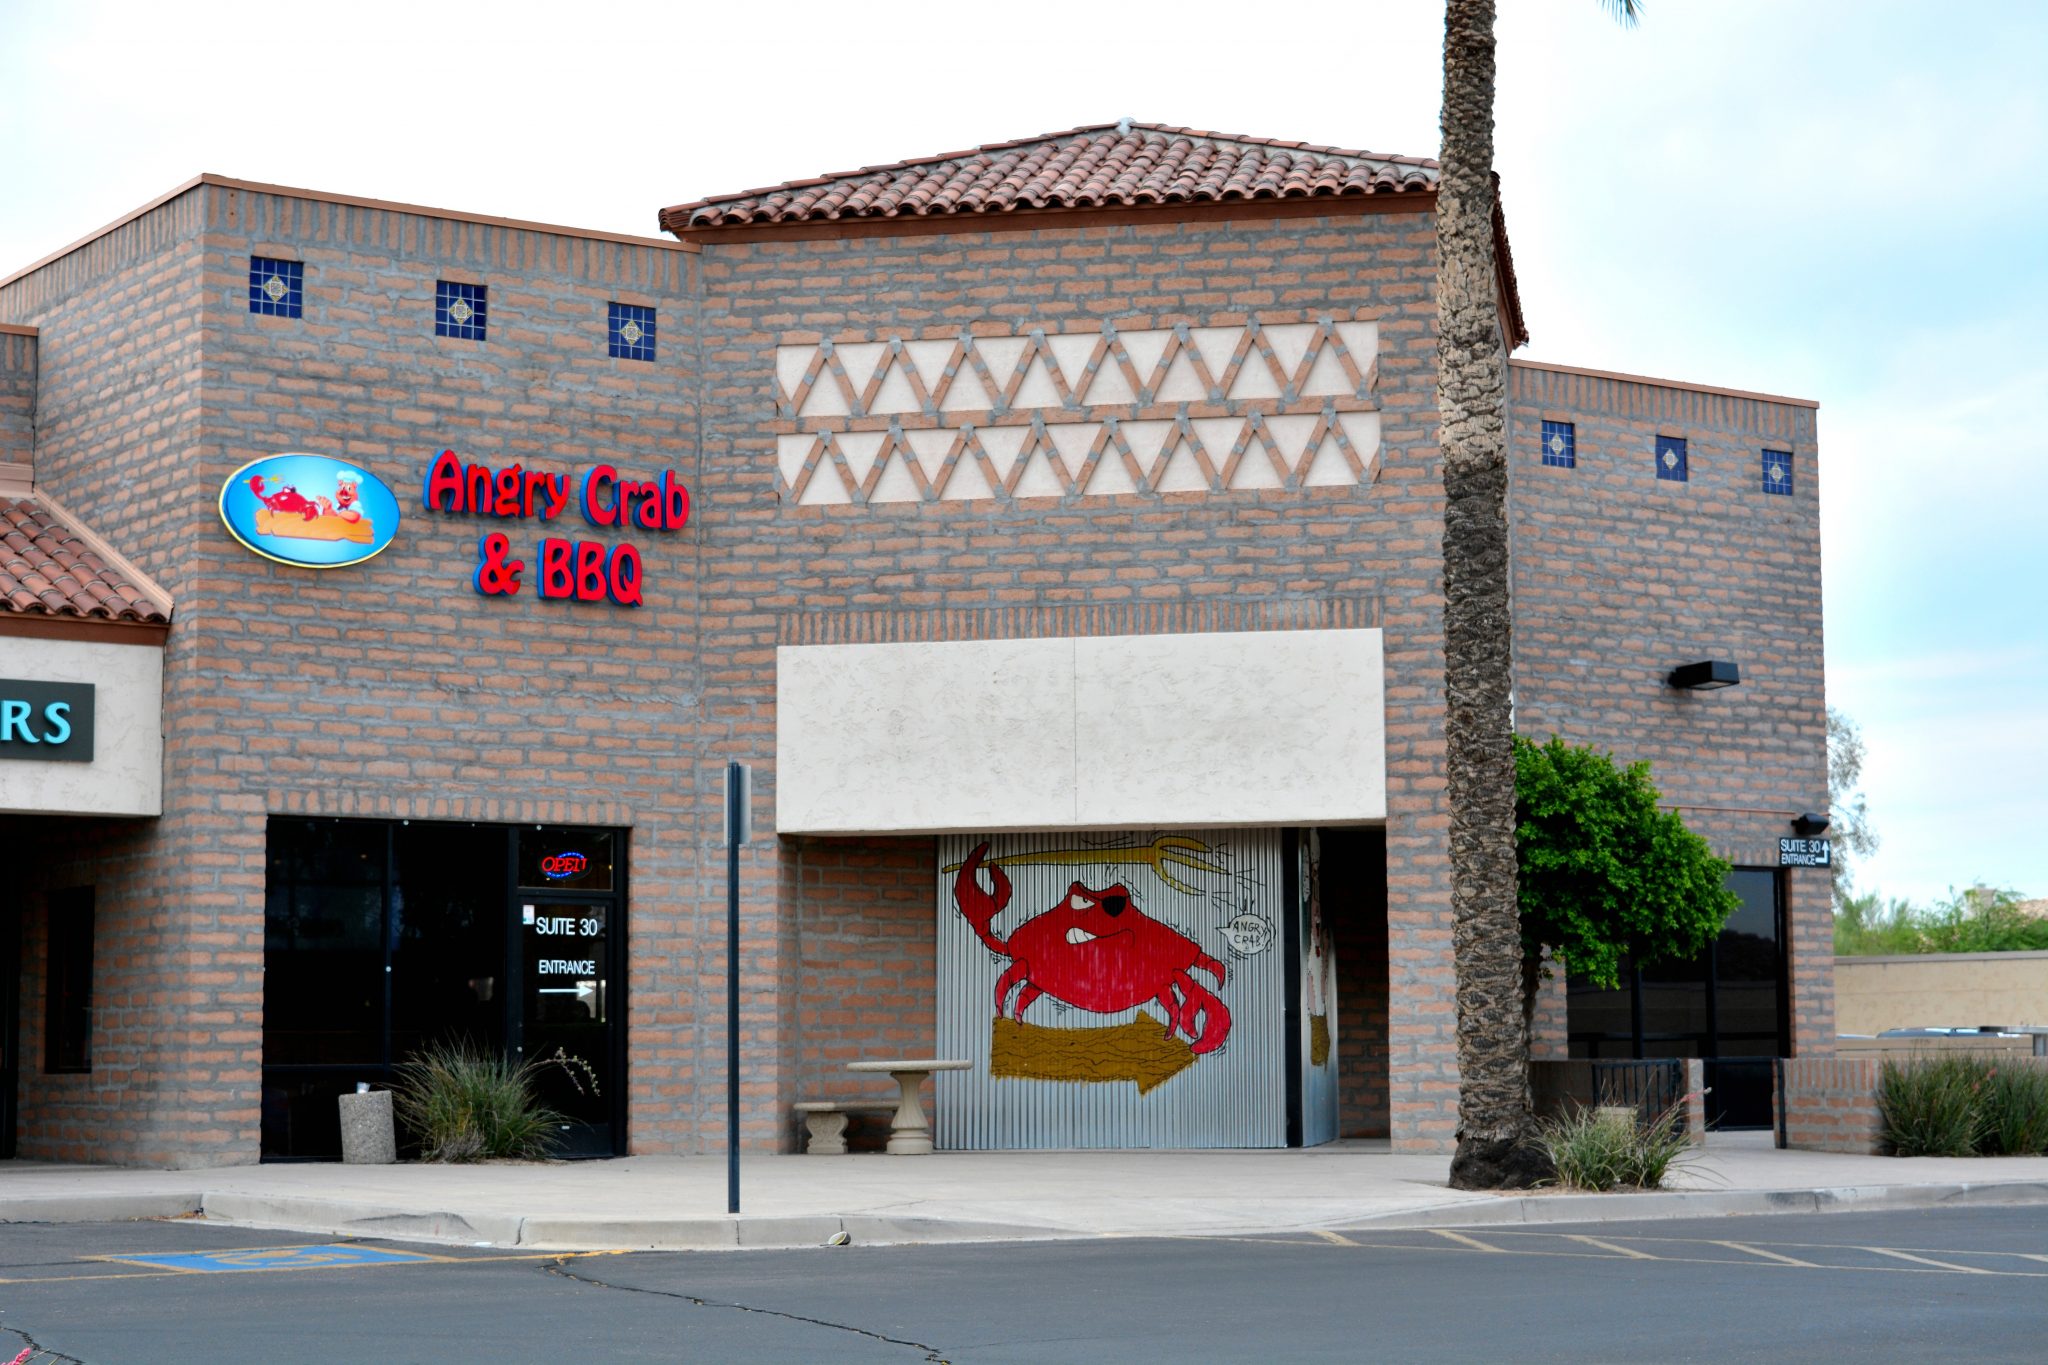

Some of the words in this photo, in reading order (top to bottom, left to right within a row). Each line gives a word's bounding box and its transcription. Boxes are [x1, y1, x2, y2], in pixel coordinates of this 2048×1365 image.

[424, 449, 571, 521] Angry
[580, 464, 690, 530] Crab
[473, 532, 526, 596] &
[538, 537, 643, 608] BBQ
[1780, 839, 1806, 852] SUITE
[1808, 840, 1821, 853] 30
[541, 856, 588, 873] OPEN
[1781, 853, 1816, 865] ENTRANCE
[536, 917, 576, 936] SUITE
[579, 918, 598, 936] 30
[1233, 921, 1266, 937] ANGRY
[538, 959, 596, 975] ENTRANCE
